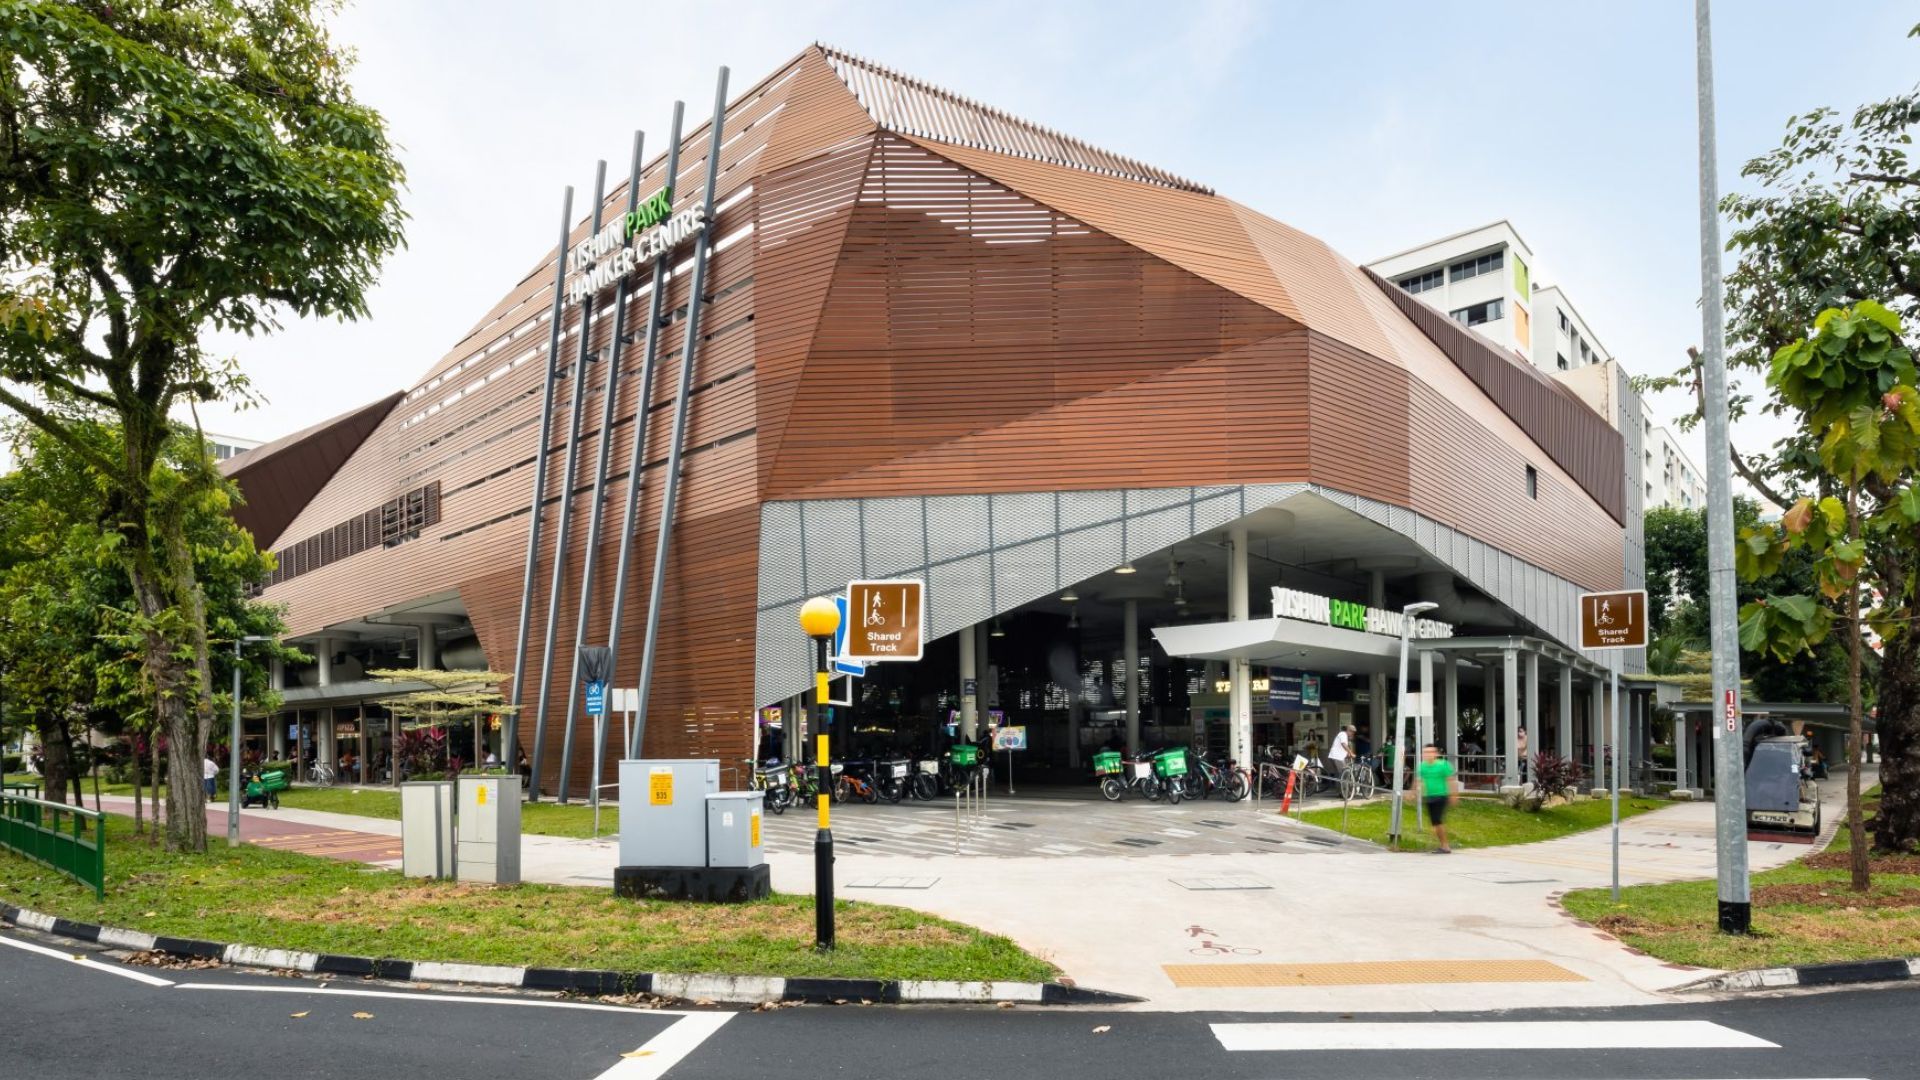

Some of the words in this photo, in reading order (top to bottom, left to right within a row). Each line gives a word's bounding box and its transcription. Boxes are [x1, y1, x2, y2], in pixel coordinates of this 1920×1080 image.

[568, 219, 625, 274] YISHUN
[625, 186, 672, 240] PARK
[570, 247, 637, 305] HAWKER
[636, 202, 706, 264] CENTRE
[1271, 586, 1330, 624] YISHUN
[1330, 598, 1367, 632] PARK
[1415, 618, 1454, 639] CENTRE
[1598, 628, 1629, 636] Shared
[867, 631, 902, 641] Shared
[870, 643, 897, 652] Track
[1727, 690, 1736, 732] 158
